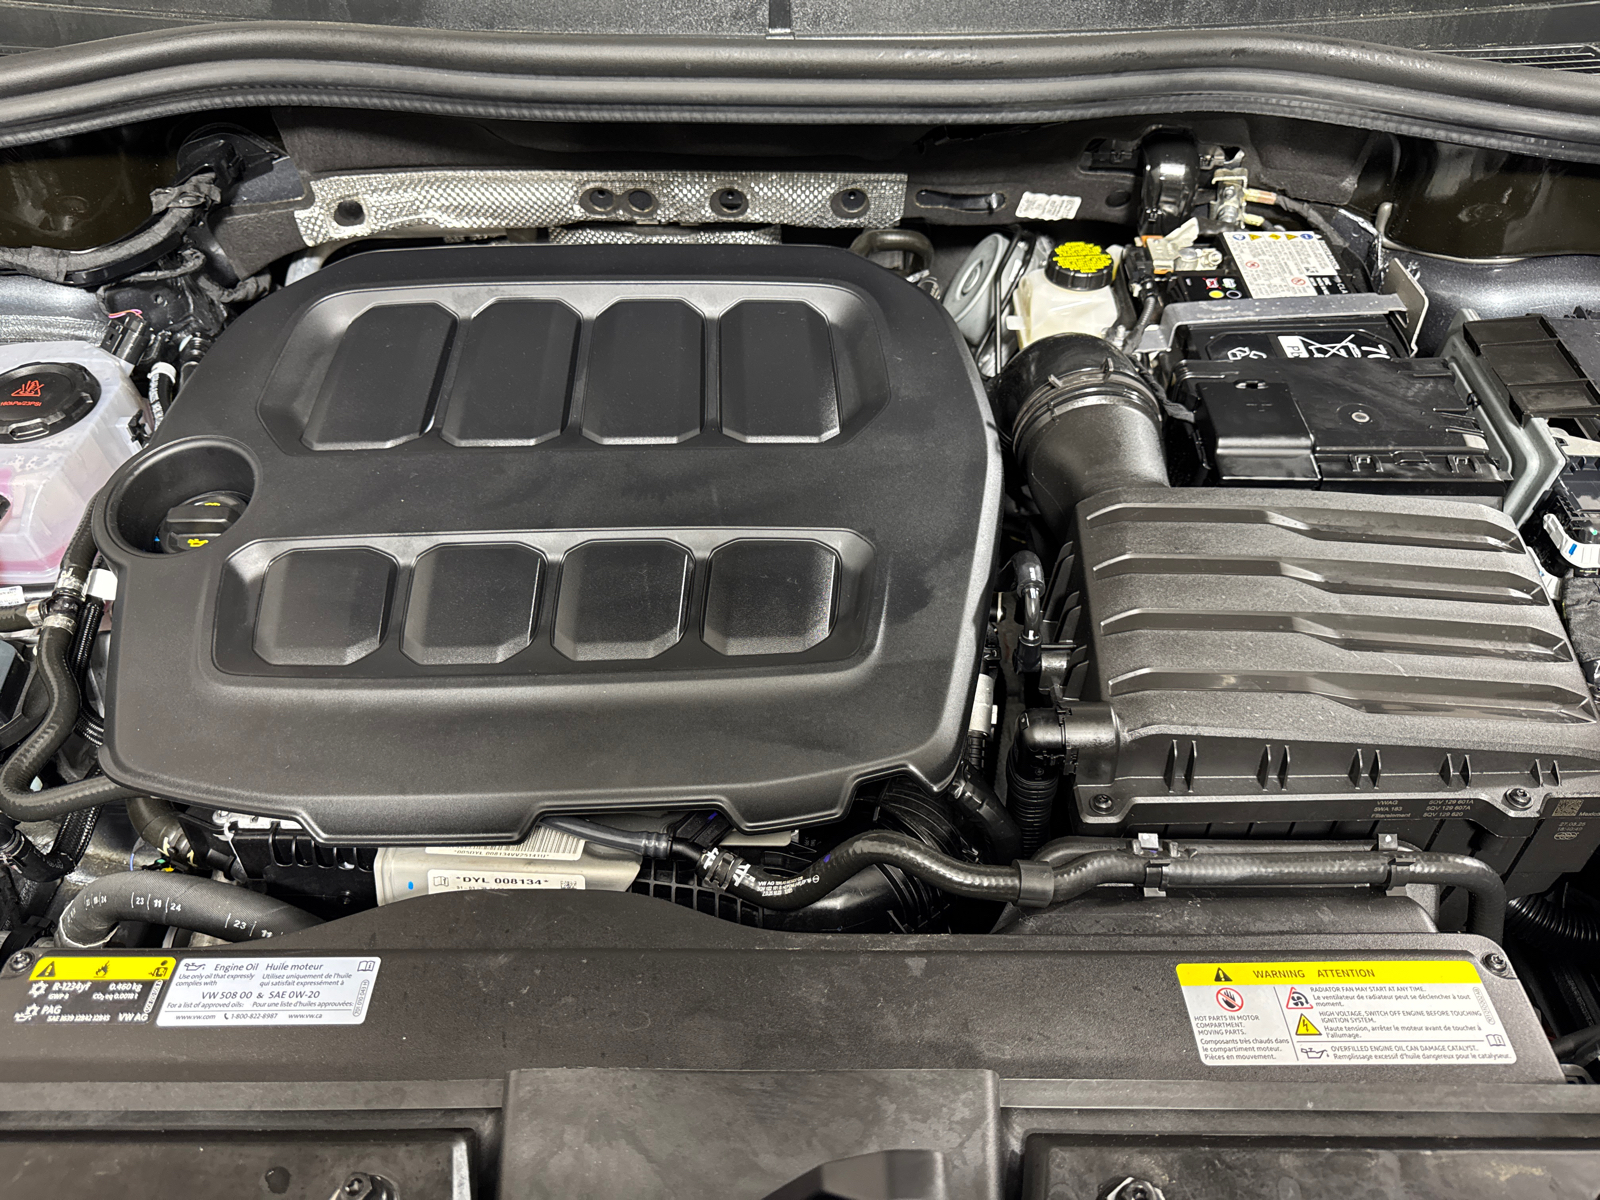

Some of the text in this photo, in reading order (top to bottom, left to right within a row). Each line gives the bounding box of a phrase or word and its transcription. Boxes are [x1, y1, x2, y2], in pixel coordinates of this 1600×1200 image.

[135, 896, 145, 906] 23
[169, 903, 182, 912] 24
[234, 919, 247, 930] 23
[214, 962, 260, 973] Engine Oil
[265, 962, 324, 971] Huile moteur
[190, 973, 204, 981] only
[226, 973, 256, 981] expressly
[285, 973, 325, 981] uniquement
[1252, 969, 1306, 980] WARNING
[1317, 968, 1375, 979] ATTENTION
[52, 982, 92, 993] R-1234yf
[109, 982, 143, 993] 0.460 kg
[175, 980, 203, 988] complies
[296, 979, 339, 988] expressément
[201, 991, 220, 1000] VW
[219, 991, 238, 1000] 508
[239, 991, 253, 1000] 00
[268, 990, 287, 999] SAE
[288, 990, 320, 999] 0W-20
[201, 1001, 231, 1010] approved
[279, 1000, 293, 1008] liste
[40, 1004, 62, 1015] PAG
[118, 1013, 149, 1022] VW AG
[1200, 1038, 1239, 1046] Composants
[1209, 1045, 1256, 1053] compartiment
[1333, 1053, 1373, 1061] Remplissage
[1421, 1052, 1454, 1060] dangereux
